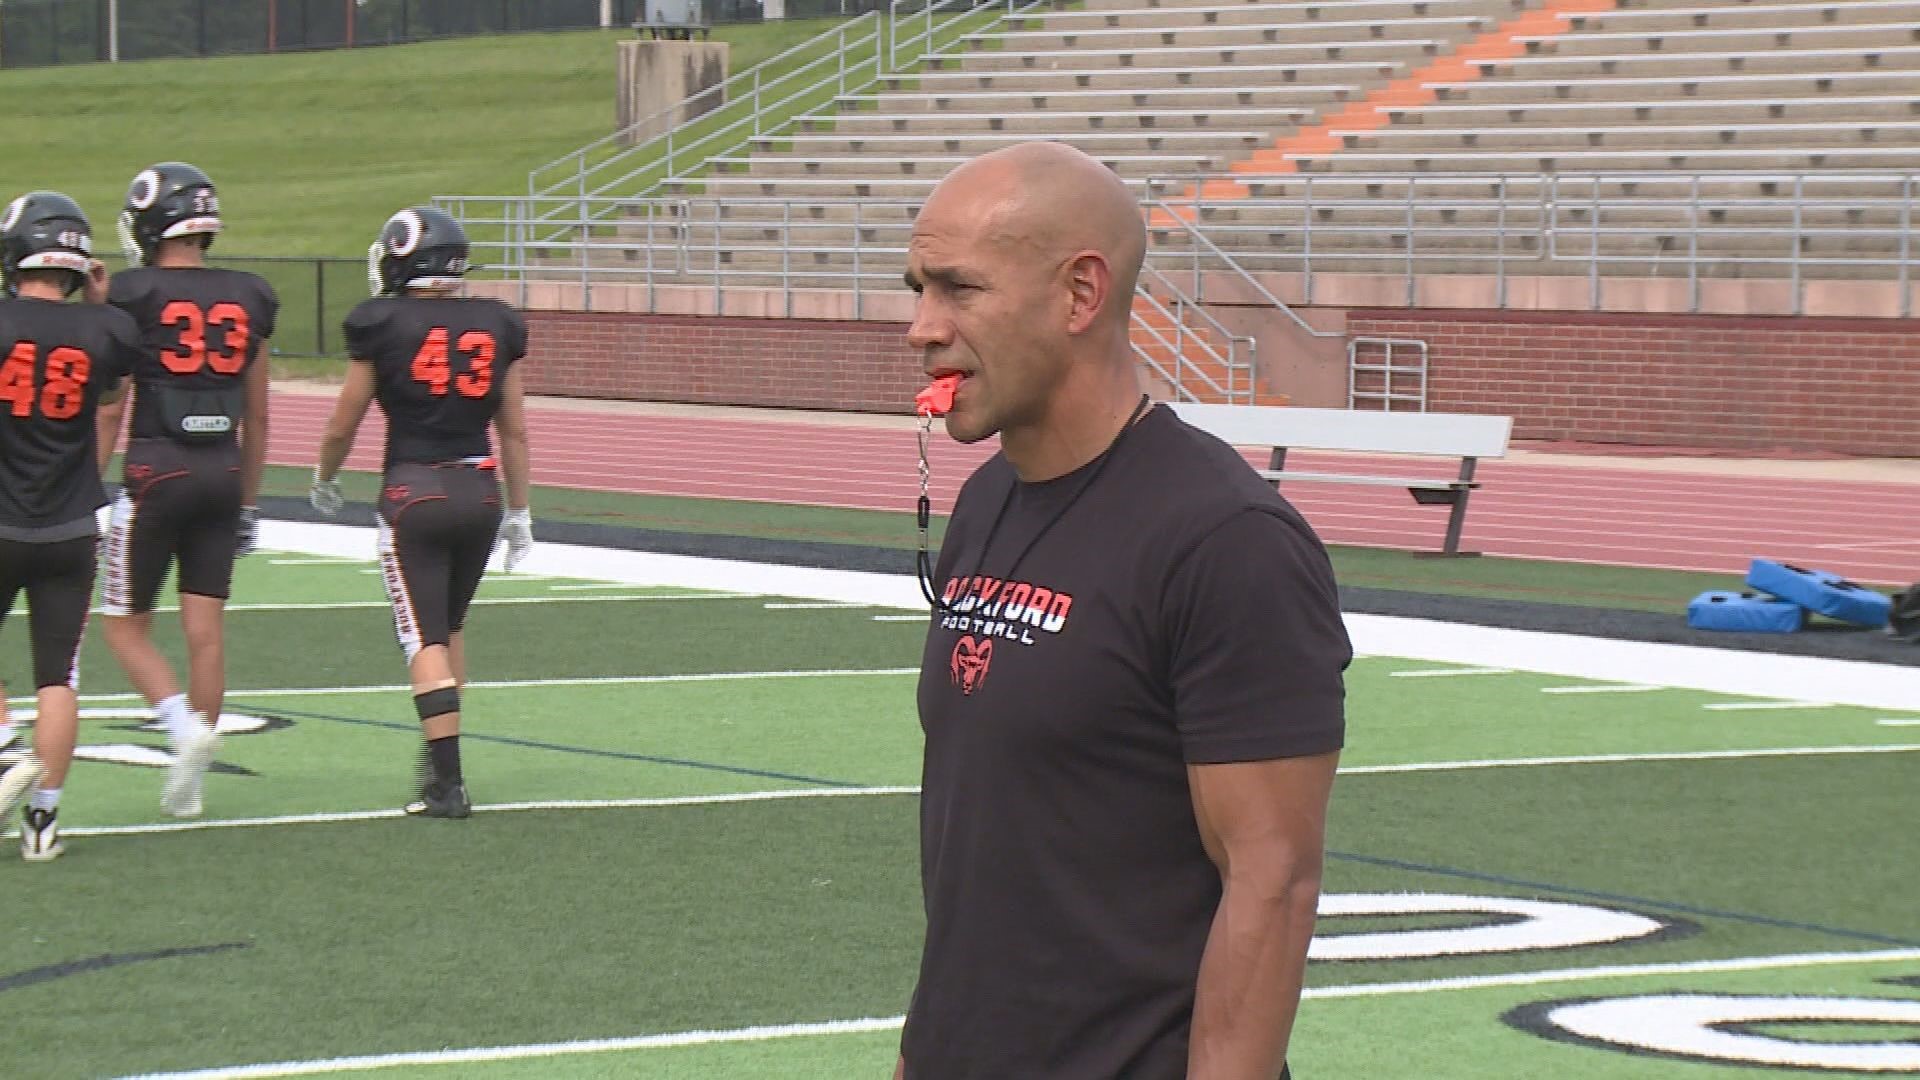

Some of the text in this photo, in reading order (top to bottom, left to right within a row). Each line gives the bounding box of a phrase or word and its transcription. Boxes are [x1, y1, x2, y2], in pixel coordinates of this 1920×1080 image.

[161, 302, 248, 373] 33
[410, 327, 496, 397] 43
[0, 342, 91, 419] 48
[940, 616, 1034, 645] FOOTBALL
